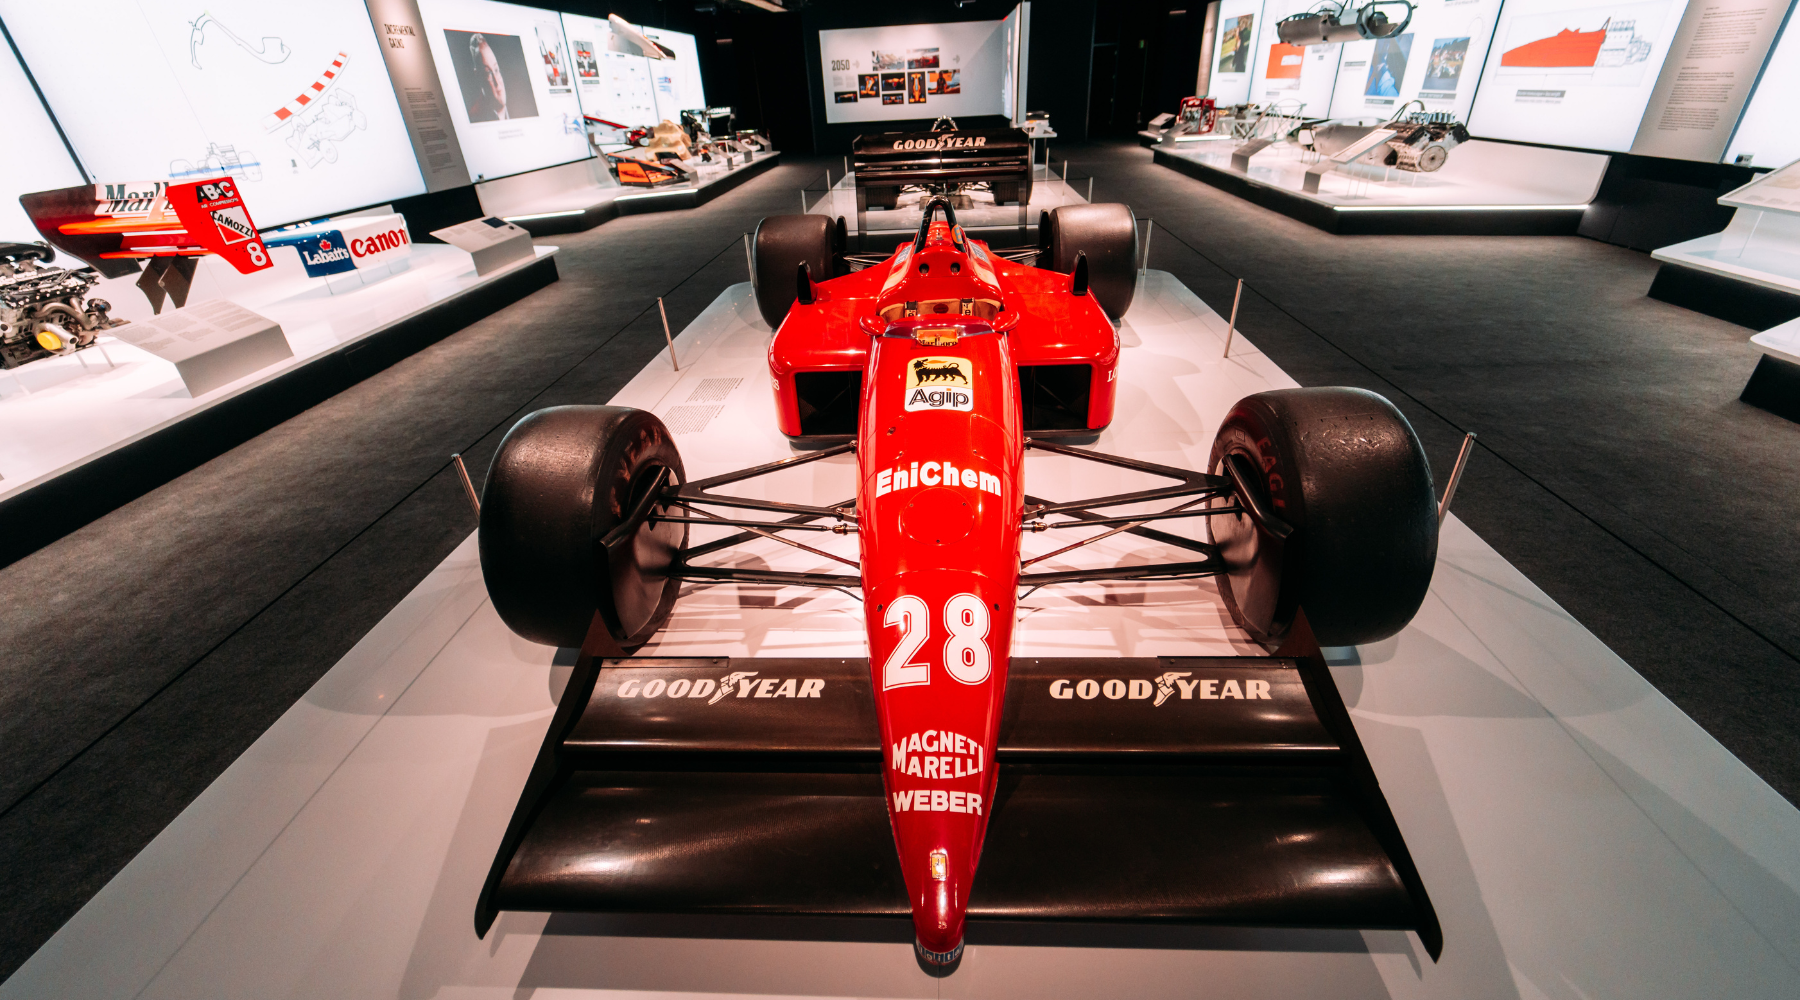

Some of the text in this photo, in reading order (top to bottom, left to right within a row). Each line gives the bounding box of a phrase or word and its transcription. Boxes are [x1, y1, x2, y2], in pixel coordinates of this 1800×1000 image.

[831, 59, 850, 71] 2050
[211, 211, 254, 238] CAMOZZI
[246, 242, 267, 267] 8
[908, 388, 969, 407] Agip
[875, 461, 1002, 498] EniChem
[882, 592, 992, 692] 28
[892, 730, 983, 762] MAGNETI
[892, 751, 983, 779] MARELLI
[892, 790, 983, 816] WEBER
